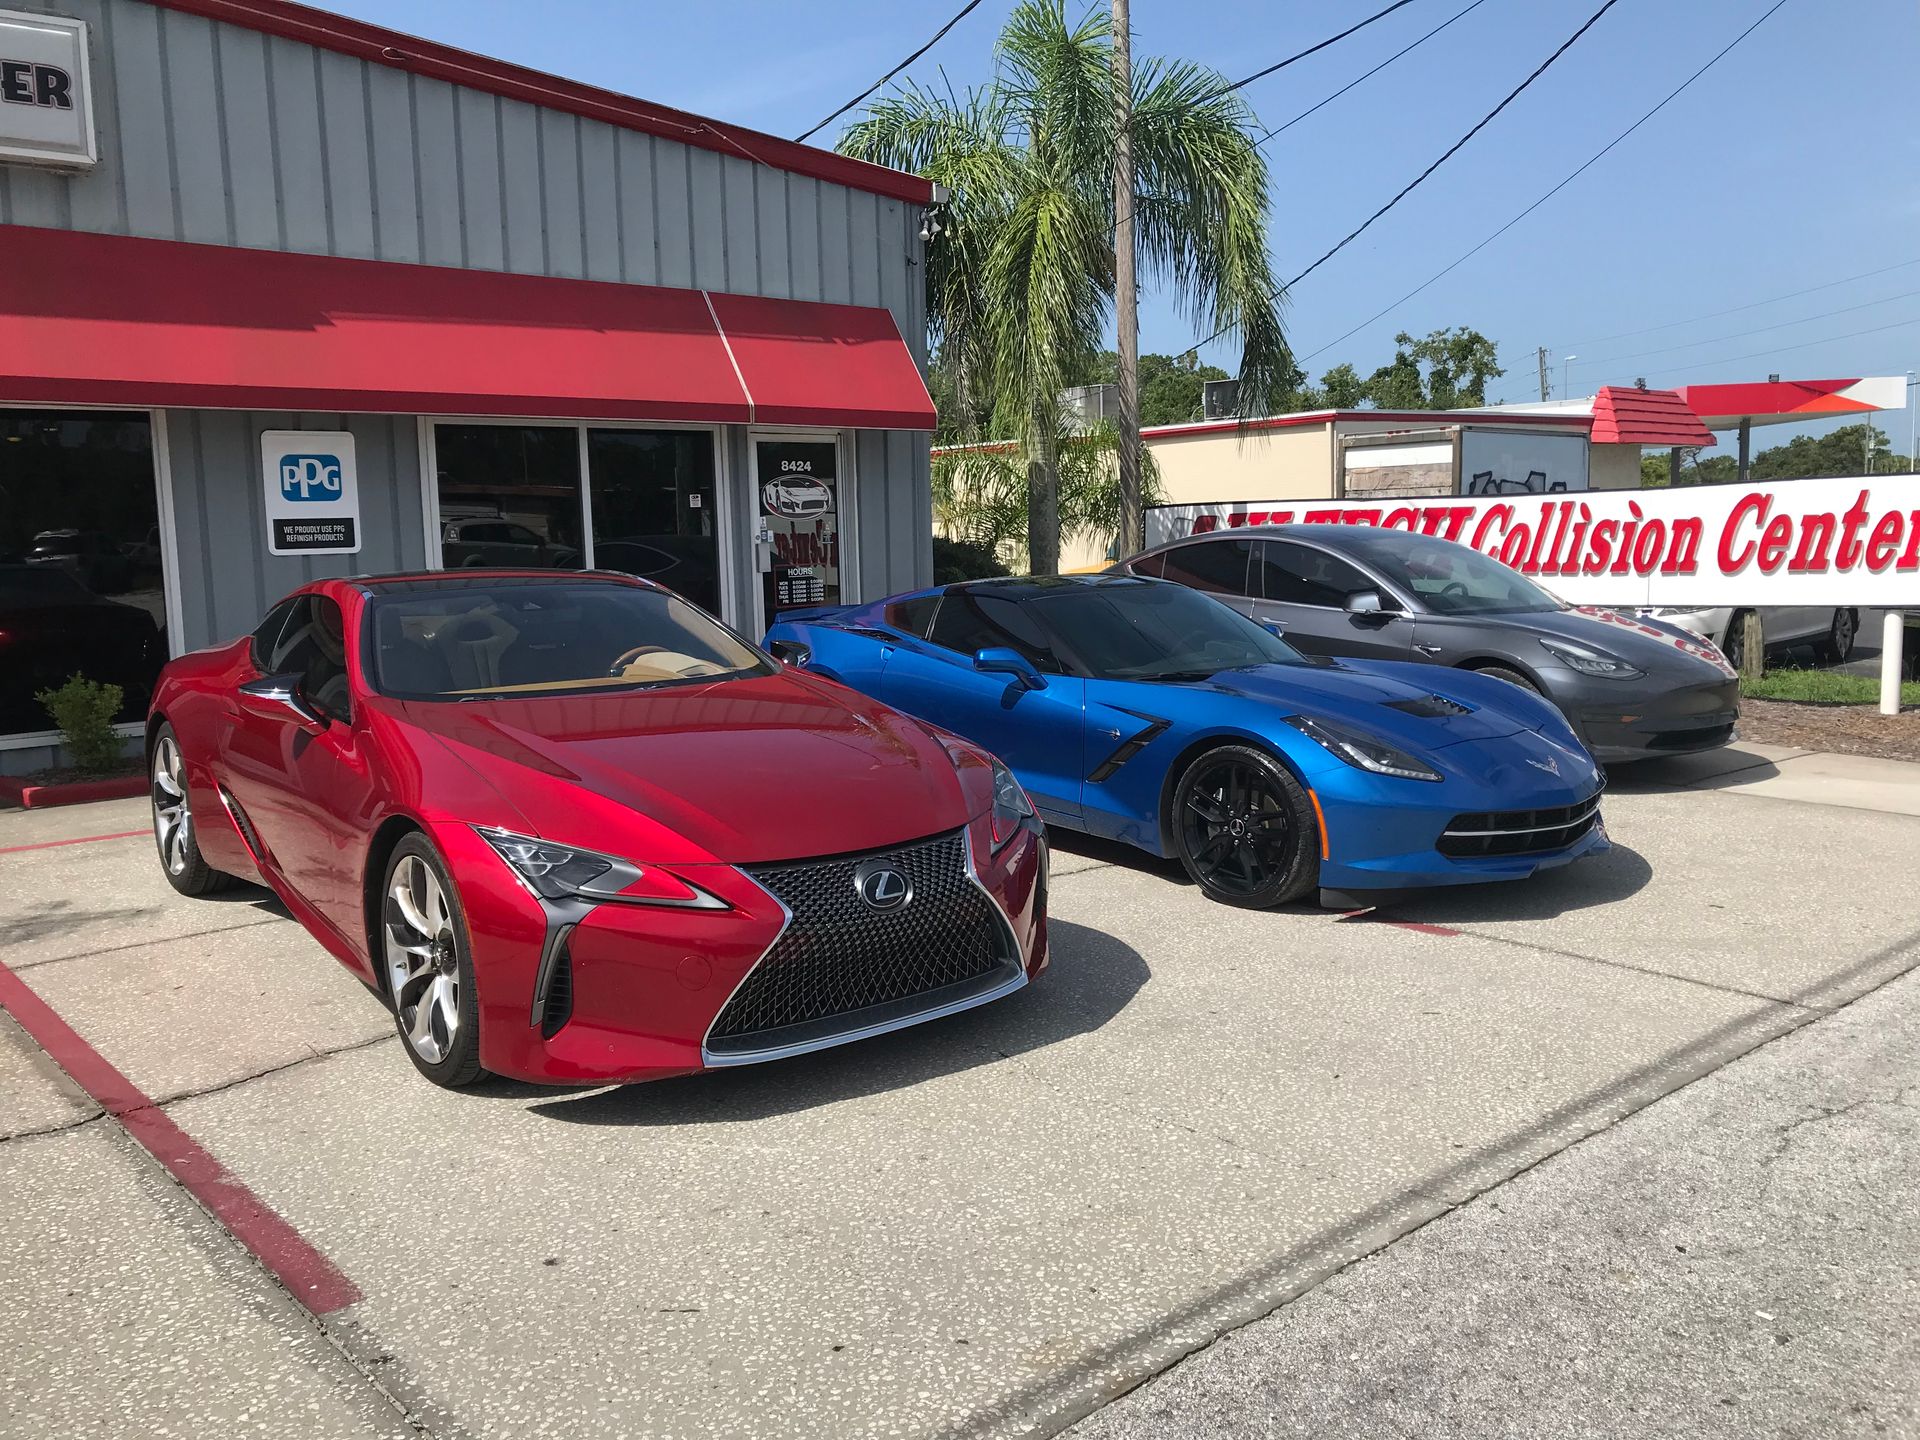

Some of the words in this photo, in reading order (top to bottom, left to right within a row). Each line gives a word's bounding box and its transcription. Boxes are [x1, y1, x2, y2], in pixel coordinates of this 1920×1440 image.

[0, 59, 73, 110] ER
[781, 460, 812, 472] 8424
[282, 458, 340, 498] PPG
[283, 525, 294, 534] WE
[294, 525, 321, 534] PROUDLY
[321, 525, 333, 533] USE
[333, 525, 345, 533] PPG
[286, 534, 313, 542] REFINISH
[313, 533, 344, 542] PRODUCTS
[1470, 500, 1704, 577] Collision
[787, 567, 813, 576] HOURS
